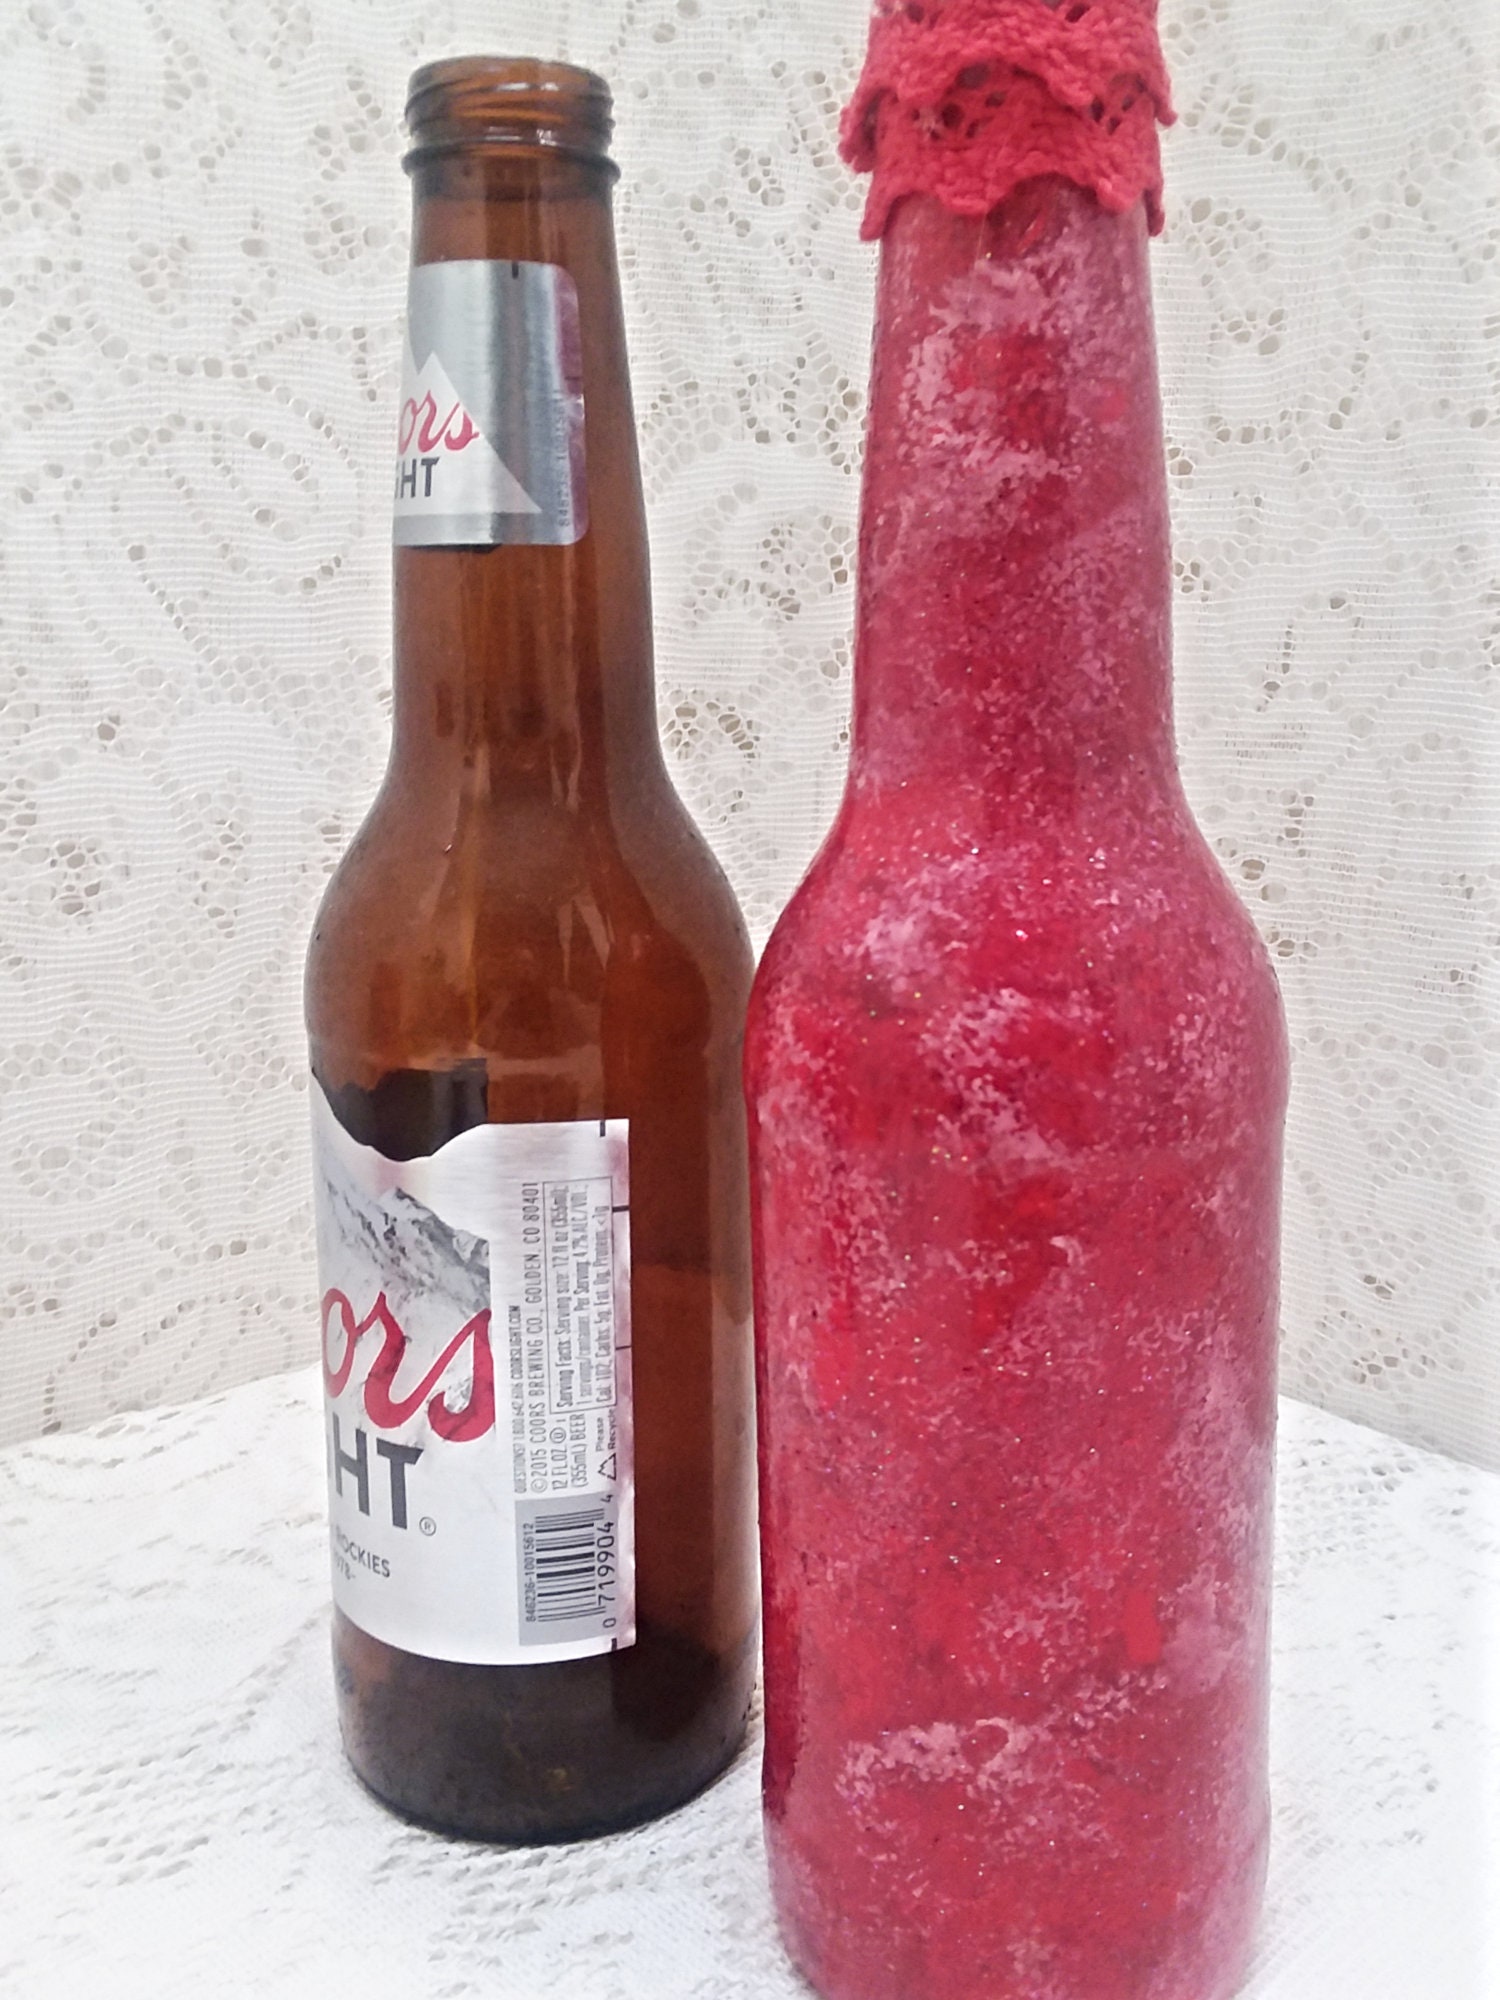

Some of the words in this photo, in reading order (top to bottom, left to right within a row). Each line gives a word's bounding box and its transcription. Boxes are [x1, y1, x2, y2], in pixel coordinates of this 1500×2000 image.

[522, 1183, 540, 1221] 80401
[523, 1227, 540, 1243] CO
[524, 1249, 542, 1303] GOLDEN,
[553, 1255, 569, 1268] 12
[555, 1297, 571, 1334] Serving
[574, 1298, 589, 1311] Per
[528, 1340, 544, 1396] BREWING
[557, 1370, 574, 1407] Serving
[529, 1402, 546, 1443] COORS
[570, 1413, 585, 1440] BEER
[596, 1418, 605, 1451] Please
[607, 1409, 617, 1449] Recycle
[571, 1444, 588, 1487] (355mL)
[552, 1480, 568, 1490] 12
[601, 1494, 614, 1503] 4
[598, 1521, 615, 1605] 719904
[603, 1618, 616, 1628] 0
